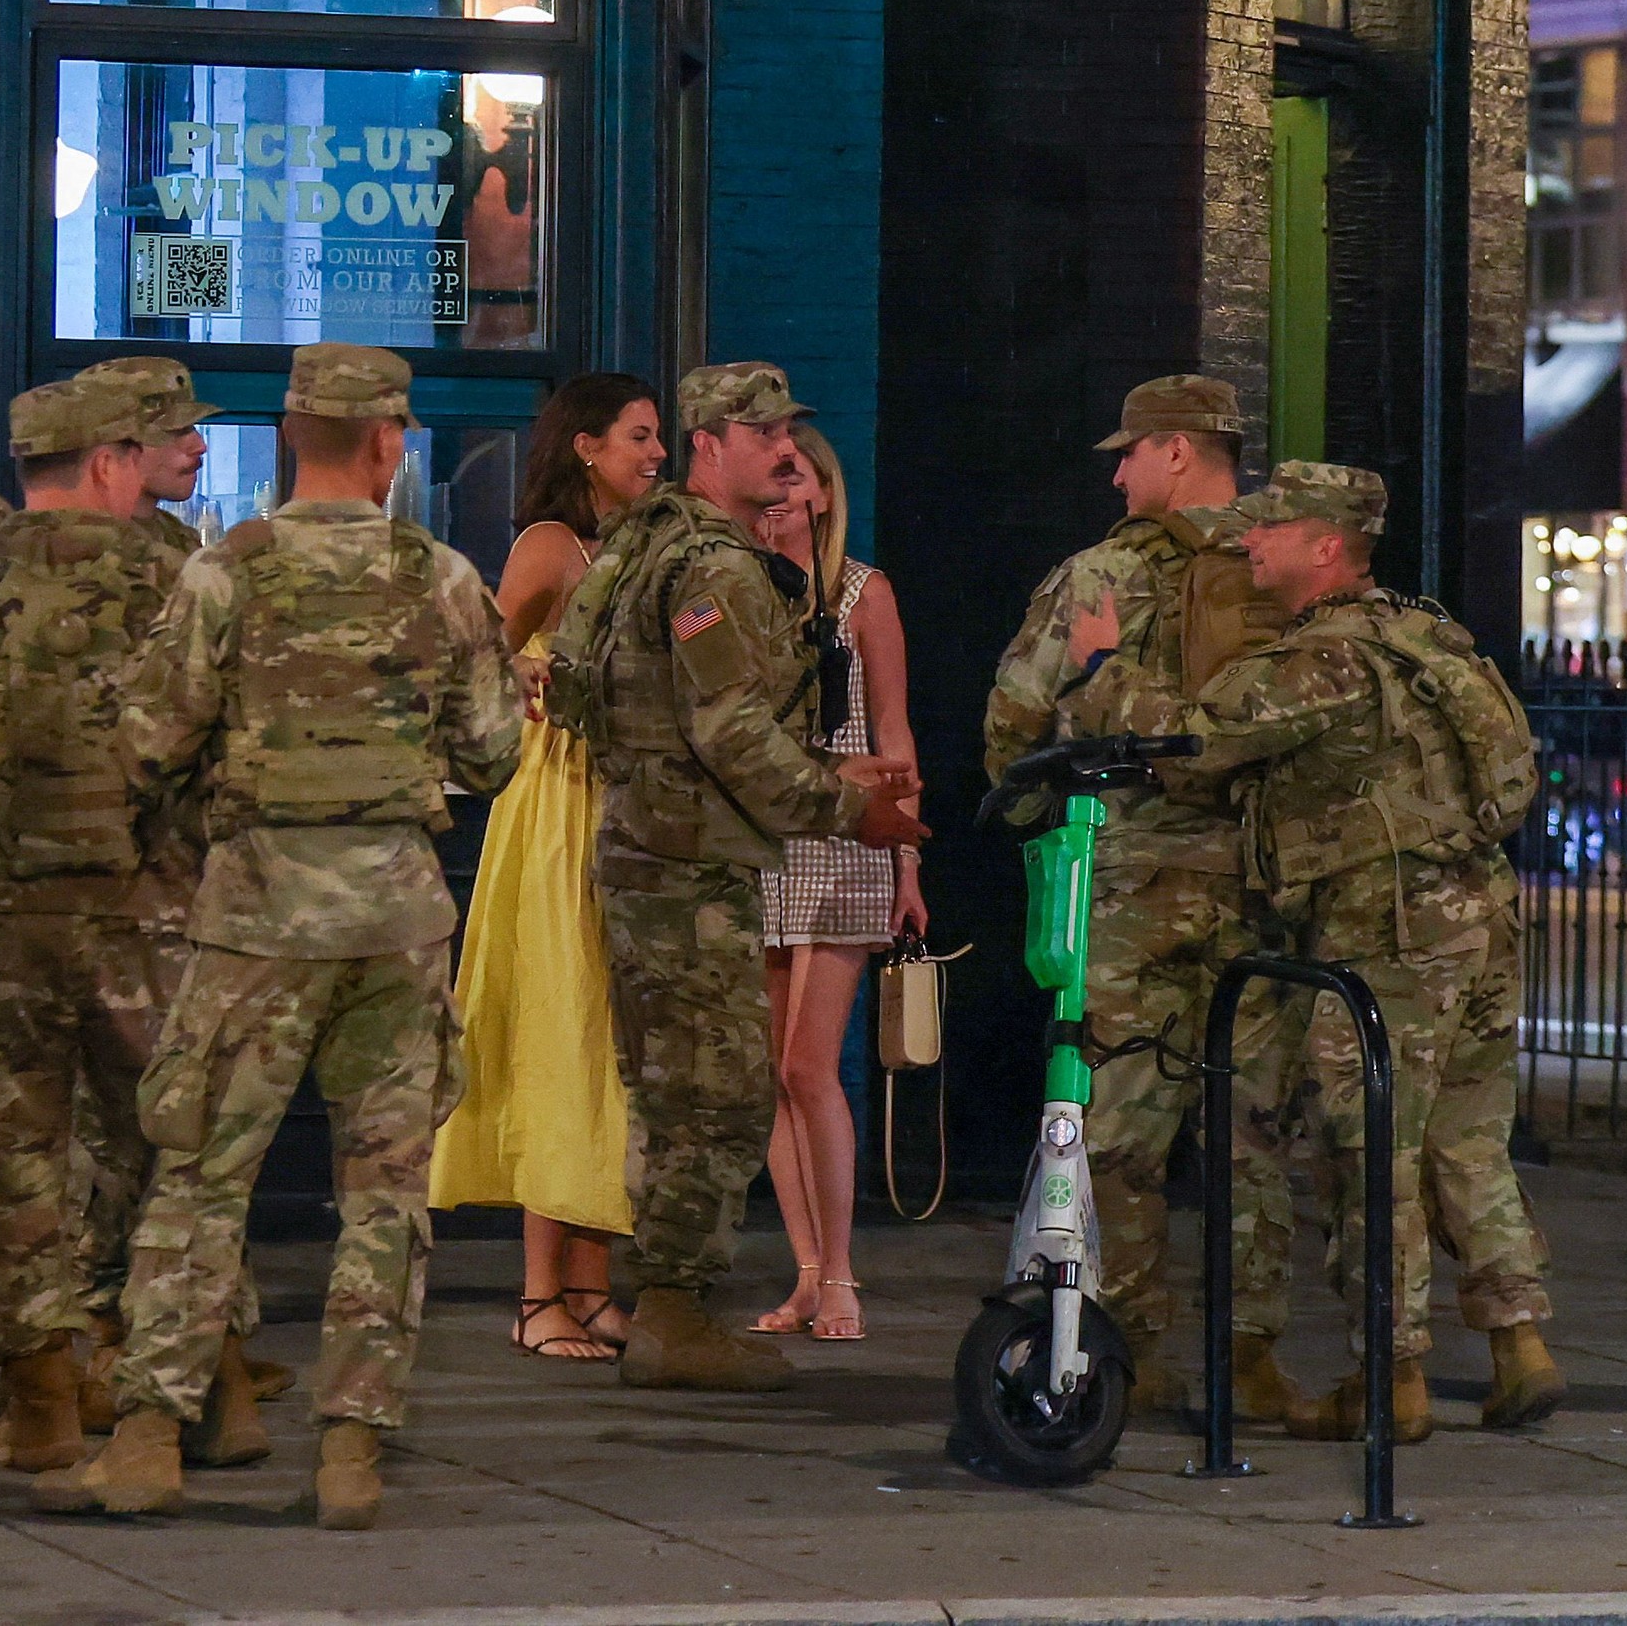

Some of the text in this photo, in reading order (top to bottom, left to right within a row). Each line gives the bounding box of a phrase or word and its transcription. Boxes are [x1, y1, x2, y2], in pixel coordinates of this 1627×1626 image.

[168, 122, 453, 172] PICK-UP
[153, 176, 455, 226] WINDOW
[327, 247, 416, 266] ONLINE
[426, 250, 457, 267] OR
[146, 273, 155, 313] ONLINE
[236, 269, 460, 294] FOM OUR APP
[372, 299, 461, 316] SERVICE!
